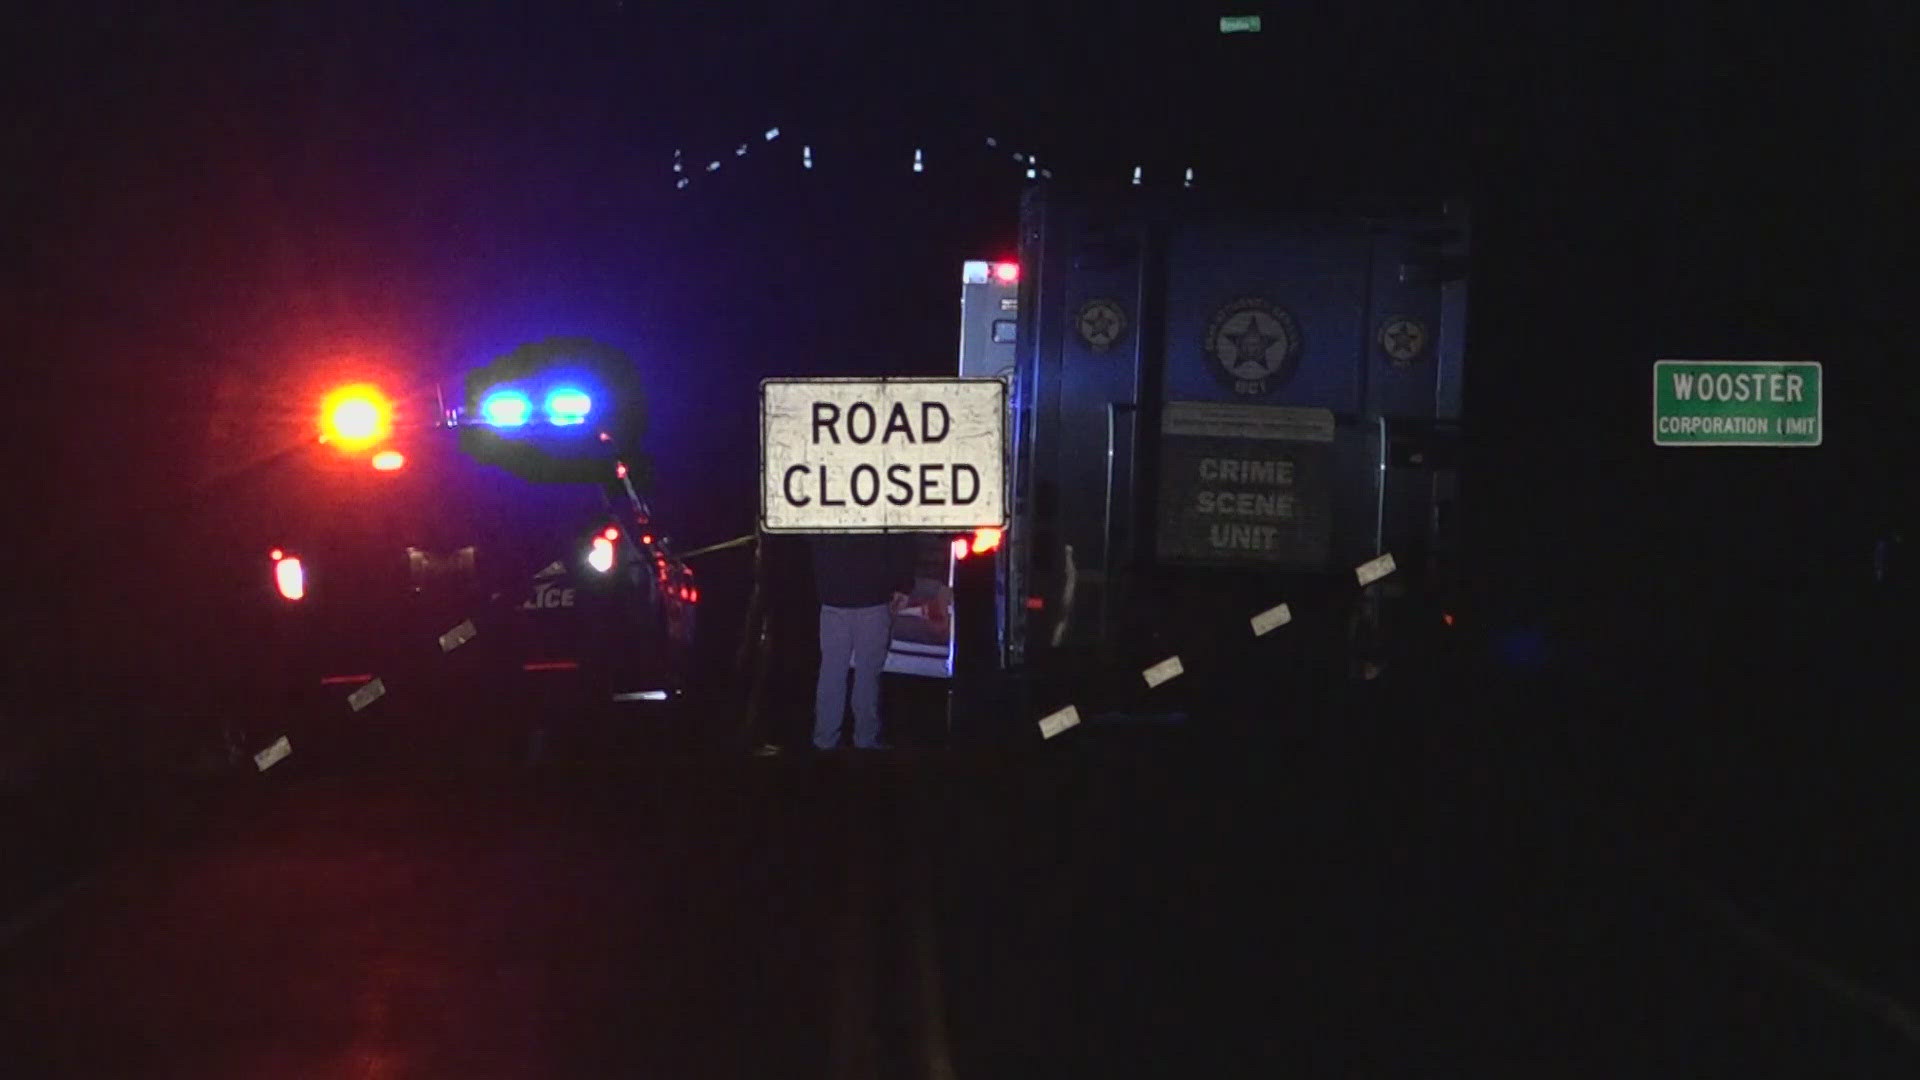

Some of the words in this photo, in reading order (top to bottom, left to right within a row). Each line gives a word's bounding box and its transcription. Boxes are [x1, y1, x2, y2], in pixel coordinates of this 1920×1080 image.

[1673, 373, 1804, 402] WOOSTER
[812, 401, 950, 444] ROAD
[1659, 416, 1768, 434] CORPORATION
[1200, 457, 1294, 485] CRIME
[783, 464, 980, 507] CLOSED
[1198, 490, 1295, 517] SCENE
[1210, 523, 1279, 550] UNIT
